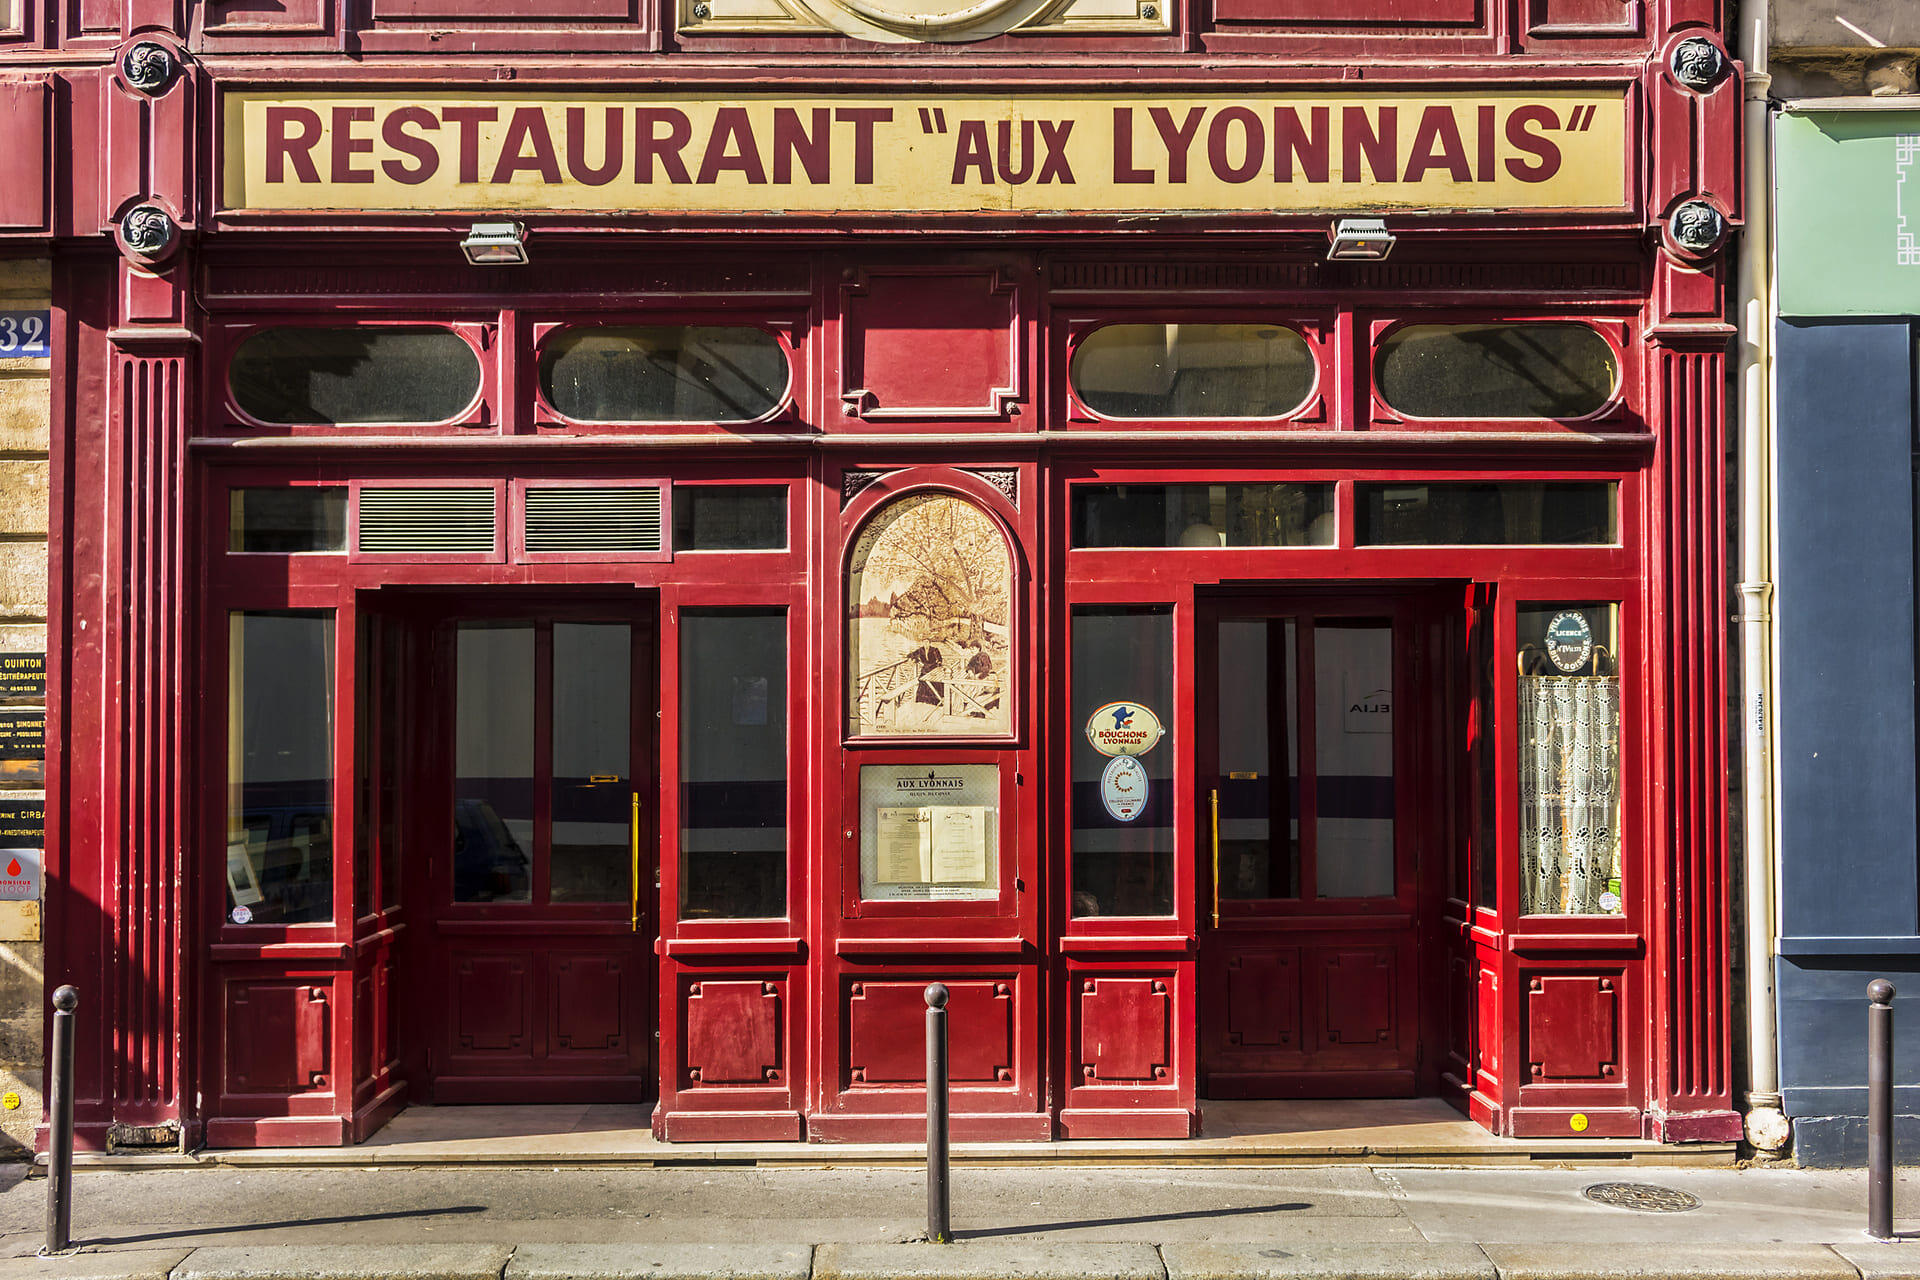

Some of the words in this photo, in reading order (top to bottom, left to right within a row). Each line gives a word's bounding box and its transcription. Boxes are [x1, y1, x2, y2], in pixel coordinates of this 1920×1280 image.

[265, 106, 894, 187] RESTAURANT
[0, 316, 44, 351] 32
[1572, 612, 1590, 633] PARIS
[896, 780, 915, 788] AUX
[918, 779, 964, 788] LYONNAIS
